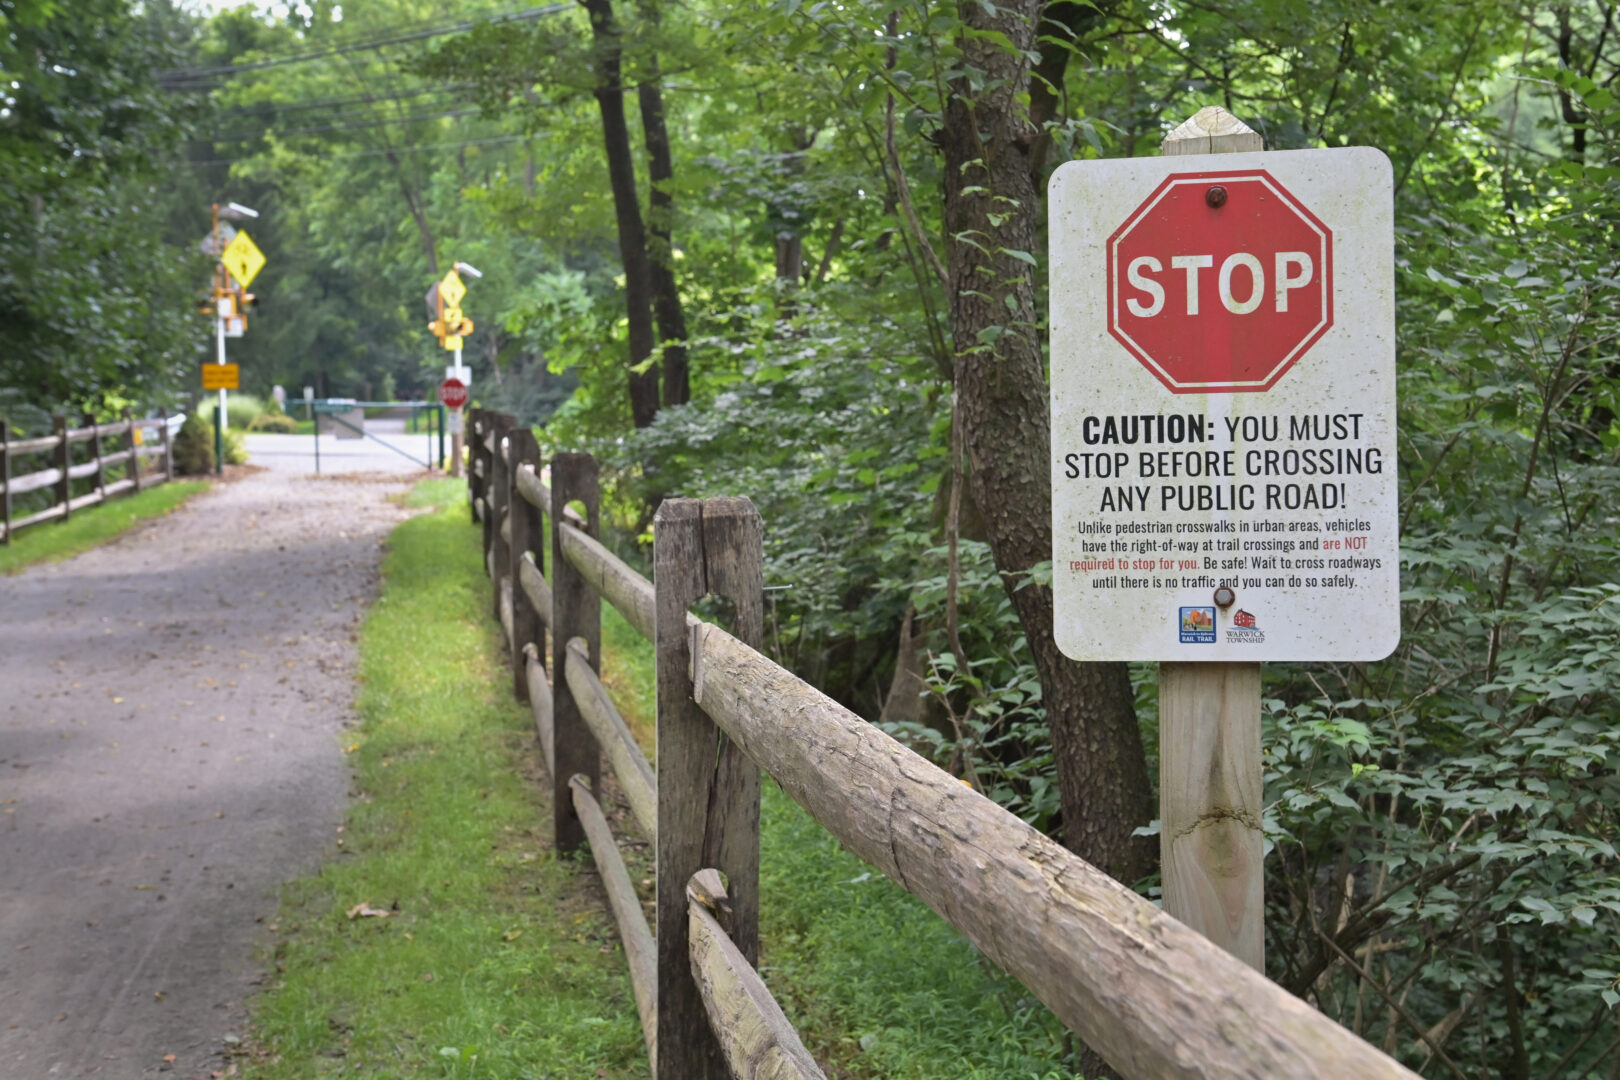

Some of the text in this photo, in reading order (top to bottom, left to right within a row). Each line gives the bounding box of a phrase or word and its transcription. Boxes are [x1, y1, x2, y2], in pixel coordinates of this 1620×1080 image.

[1126, 251, 1313, 317] STOP
[439, 387, 466, 401] STOP
[1083, 414, 1363, 444] CAUTION: YOU MUST
[1065, 448, 1383, 478] STOP BEFORE CROSSING
[1100, 483, 1346, 512] ANY PUBLIC ROAD!
[1078, 519, 1371, 536] Unlike pedestrian crosswalks in urban areas, vehicles
[1082, 536, 1368, 554] have the right-of-way at trail crossings and are NOT
[1070, 555, 1381, 572] required to stop for you. Be safe! Wait to cross roadways
[1092, 574, 1357, 589] until there is no traffic and you can do so safely.
